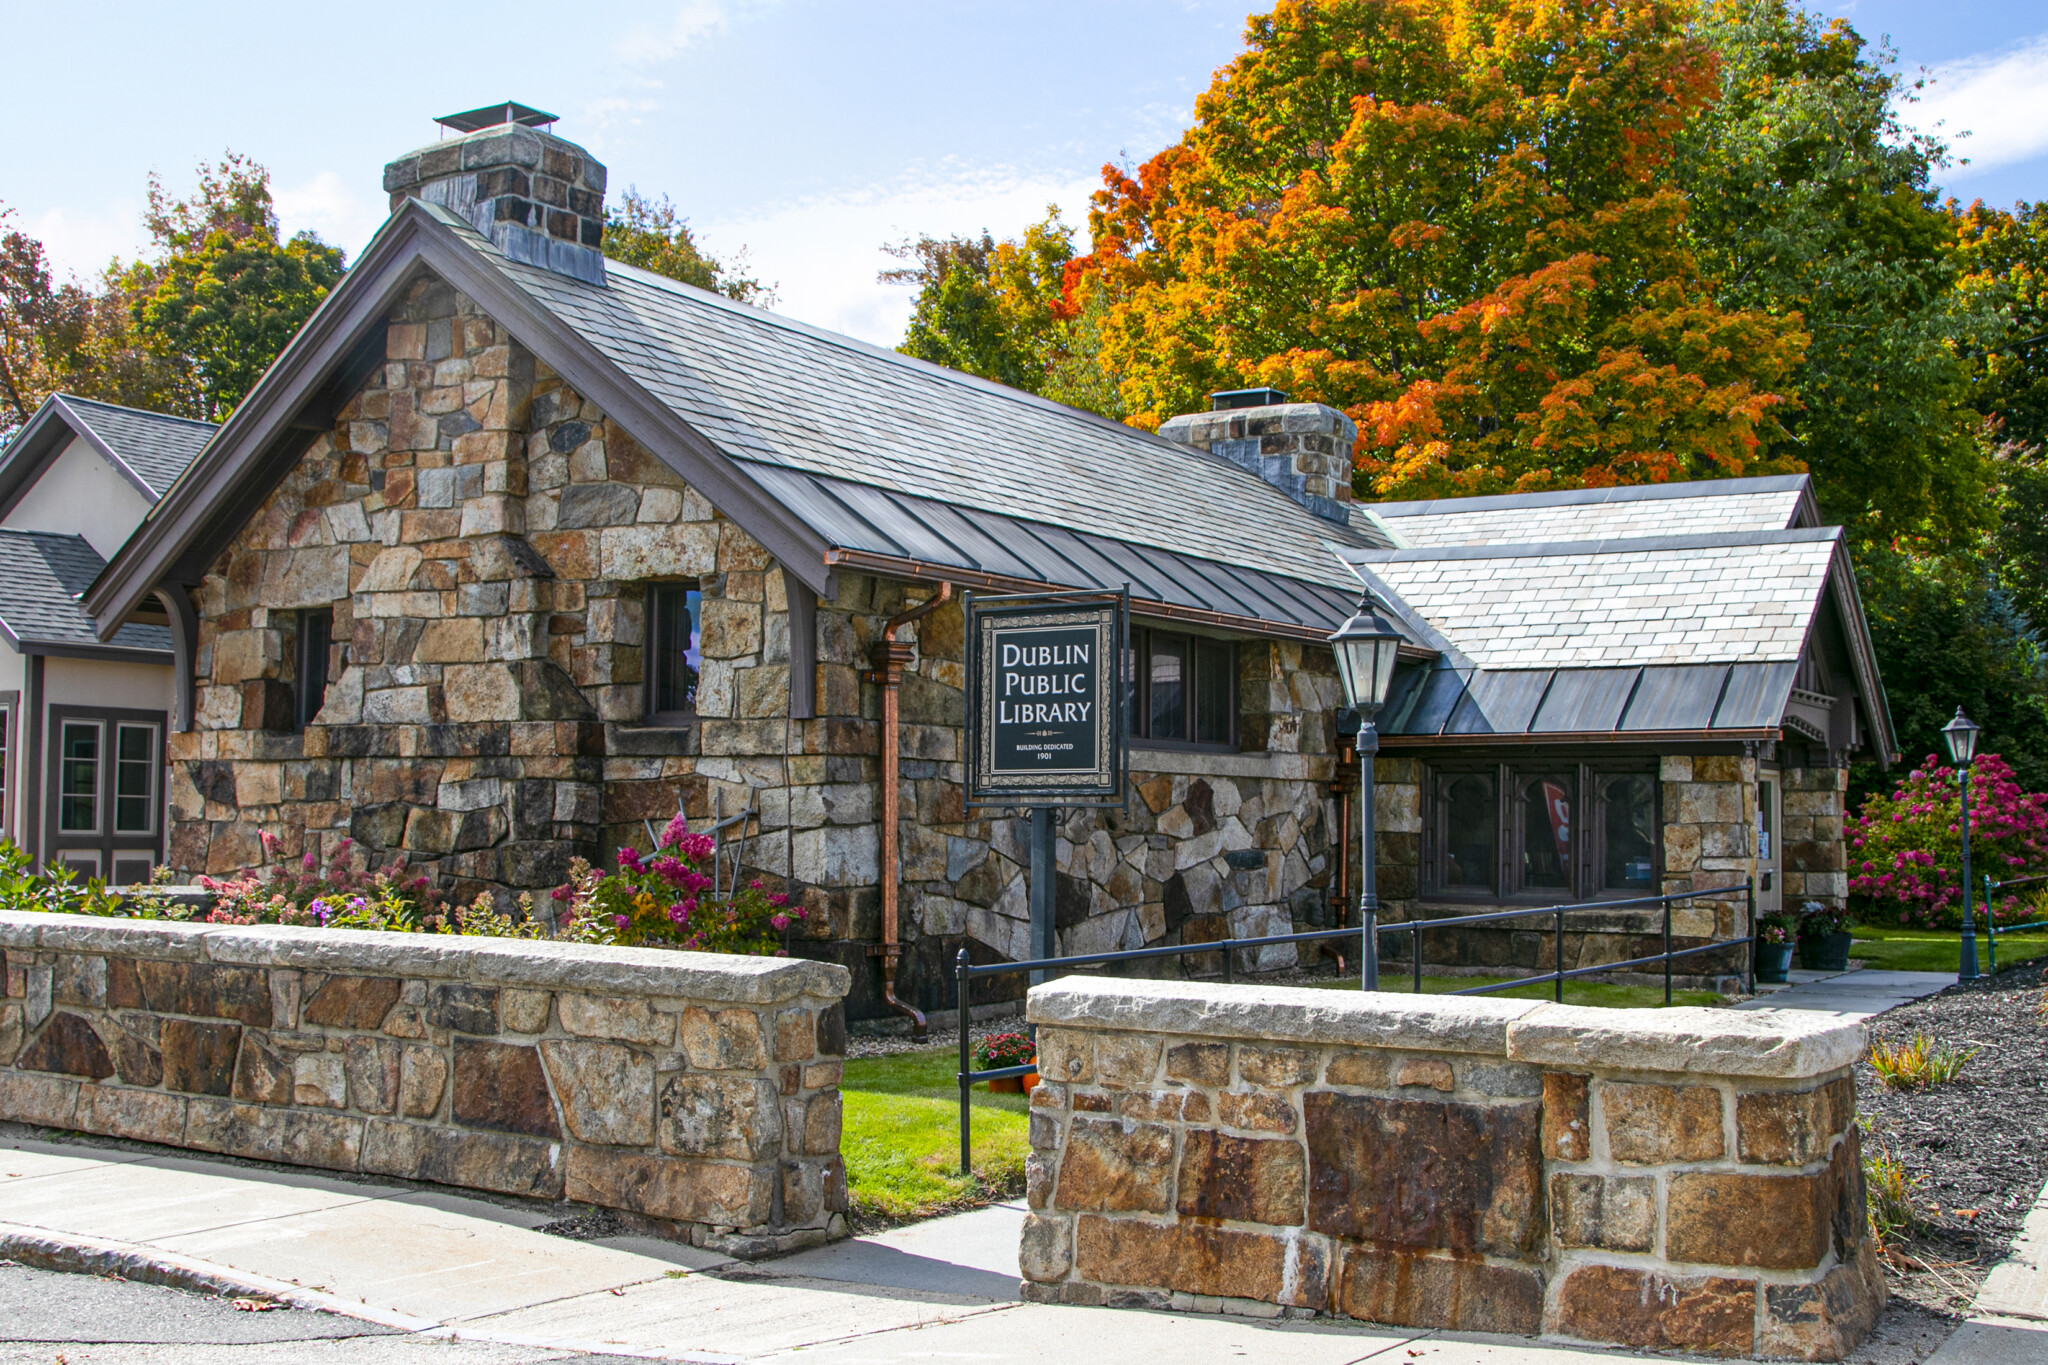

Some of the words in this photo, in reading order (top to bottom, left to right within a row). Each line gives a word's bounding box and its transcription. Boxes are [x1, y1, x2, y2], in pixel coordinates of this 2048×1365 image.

[1003, 644, 1089, 668] DUBLIN
[1005, 672, 1086, 696] PUBLIC
[999, 700, 1091, 724] LIBRARY
[1037, 752, 1052, 760] 1901
